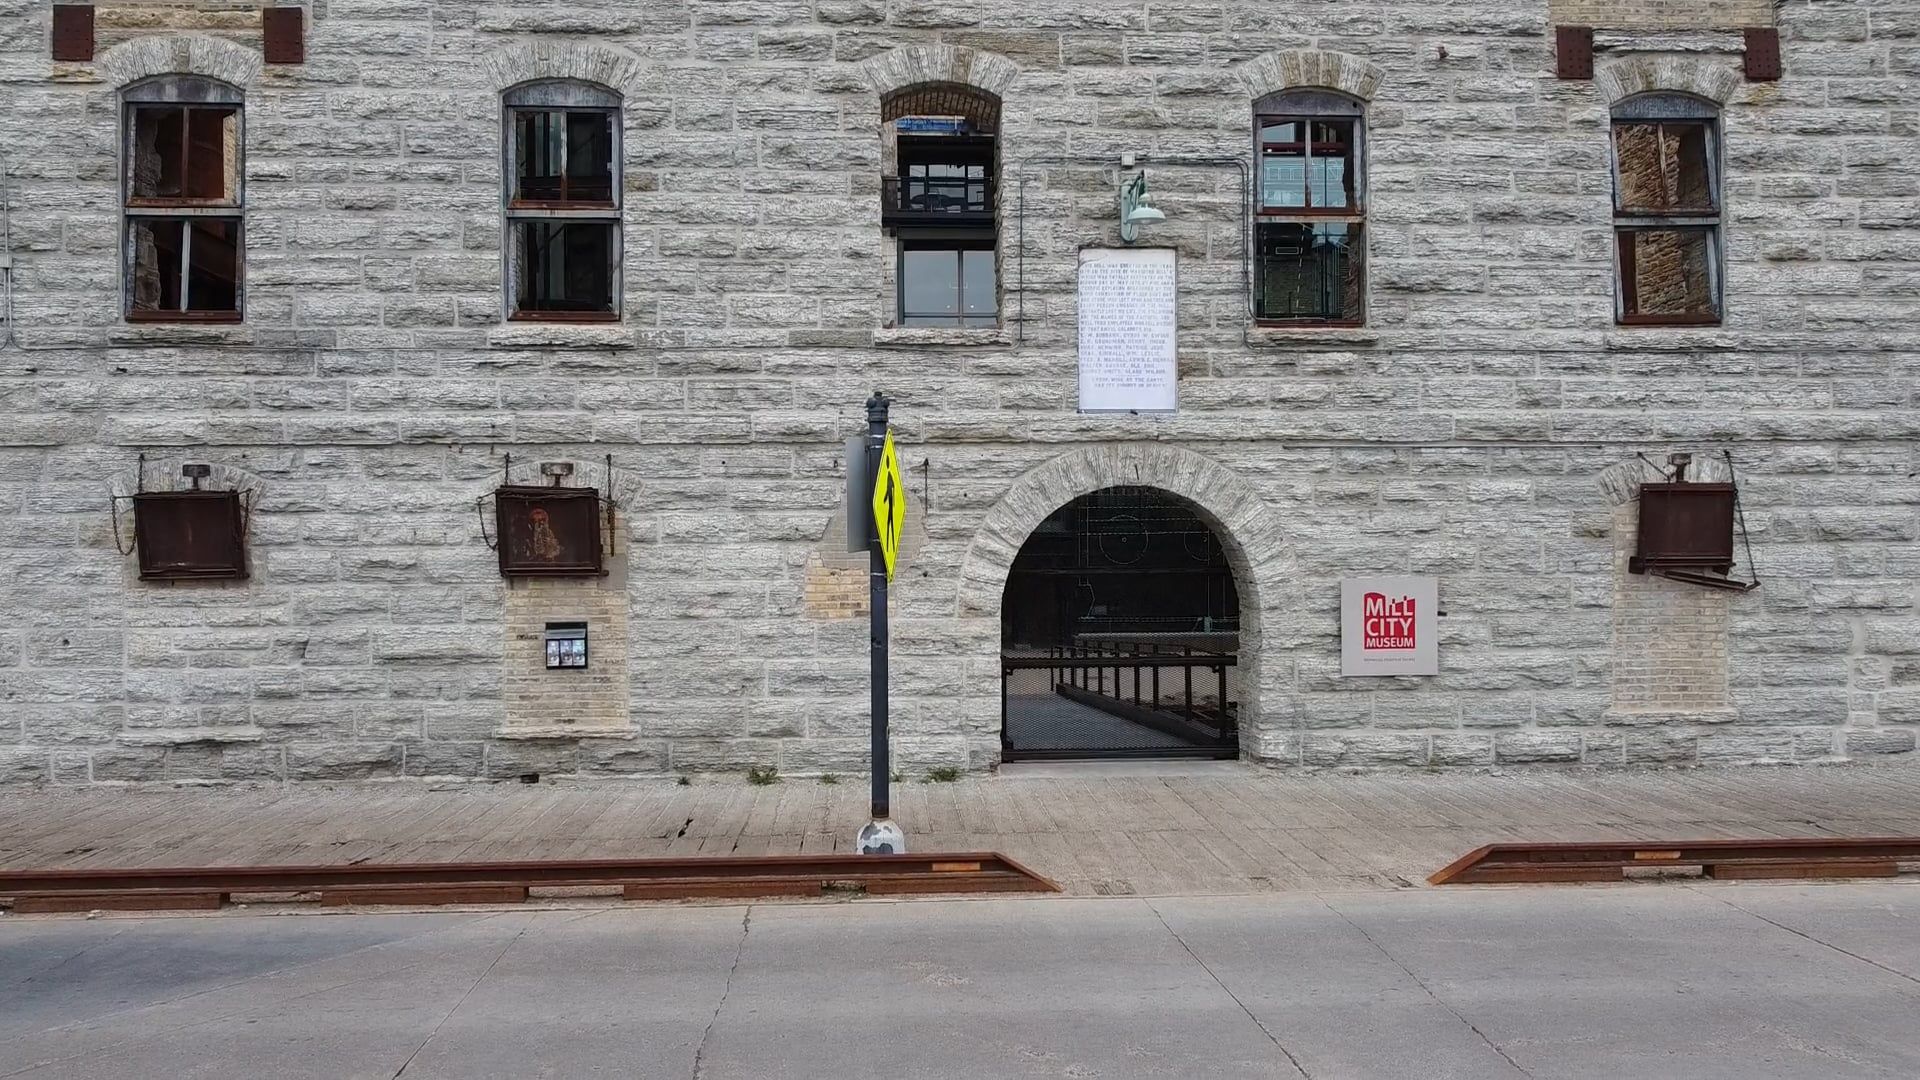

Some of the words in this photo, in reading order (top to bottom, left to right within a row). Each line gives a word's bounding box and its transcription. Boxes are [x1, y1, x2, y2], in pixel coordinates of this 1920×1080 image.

[1366, 597, 1413, 616] MILL
[1366, 618, 1413, 636] CITY
[1366, 637, 1414, 648] MUSEUM
